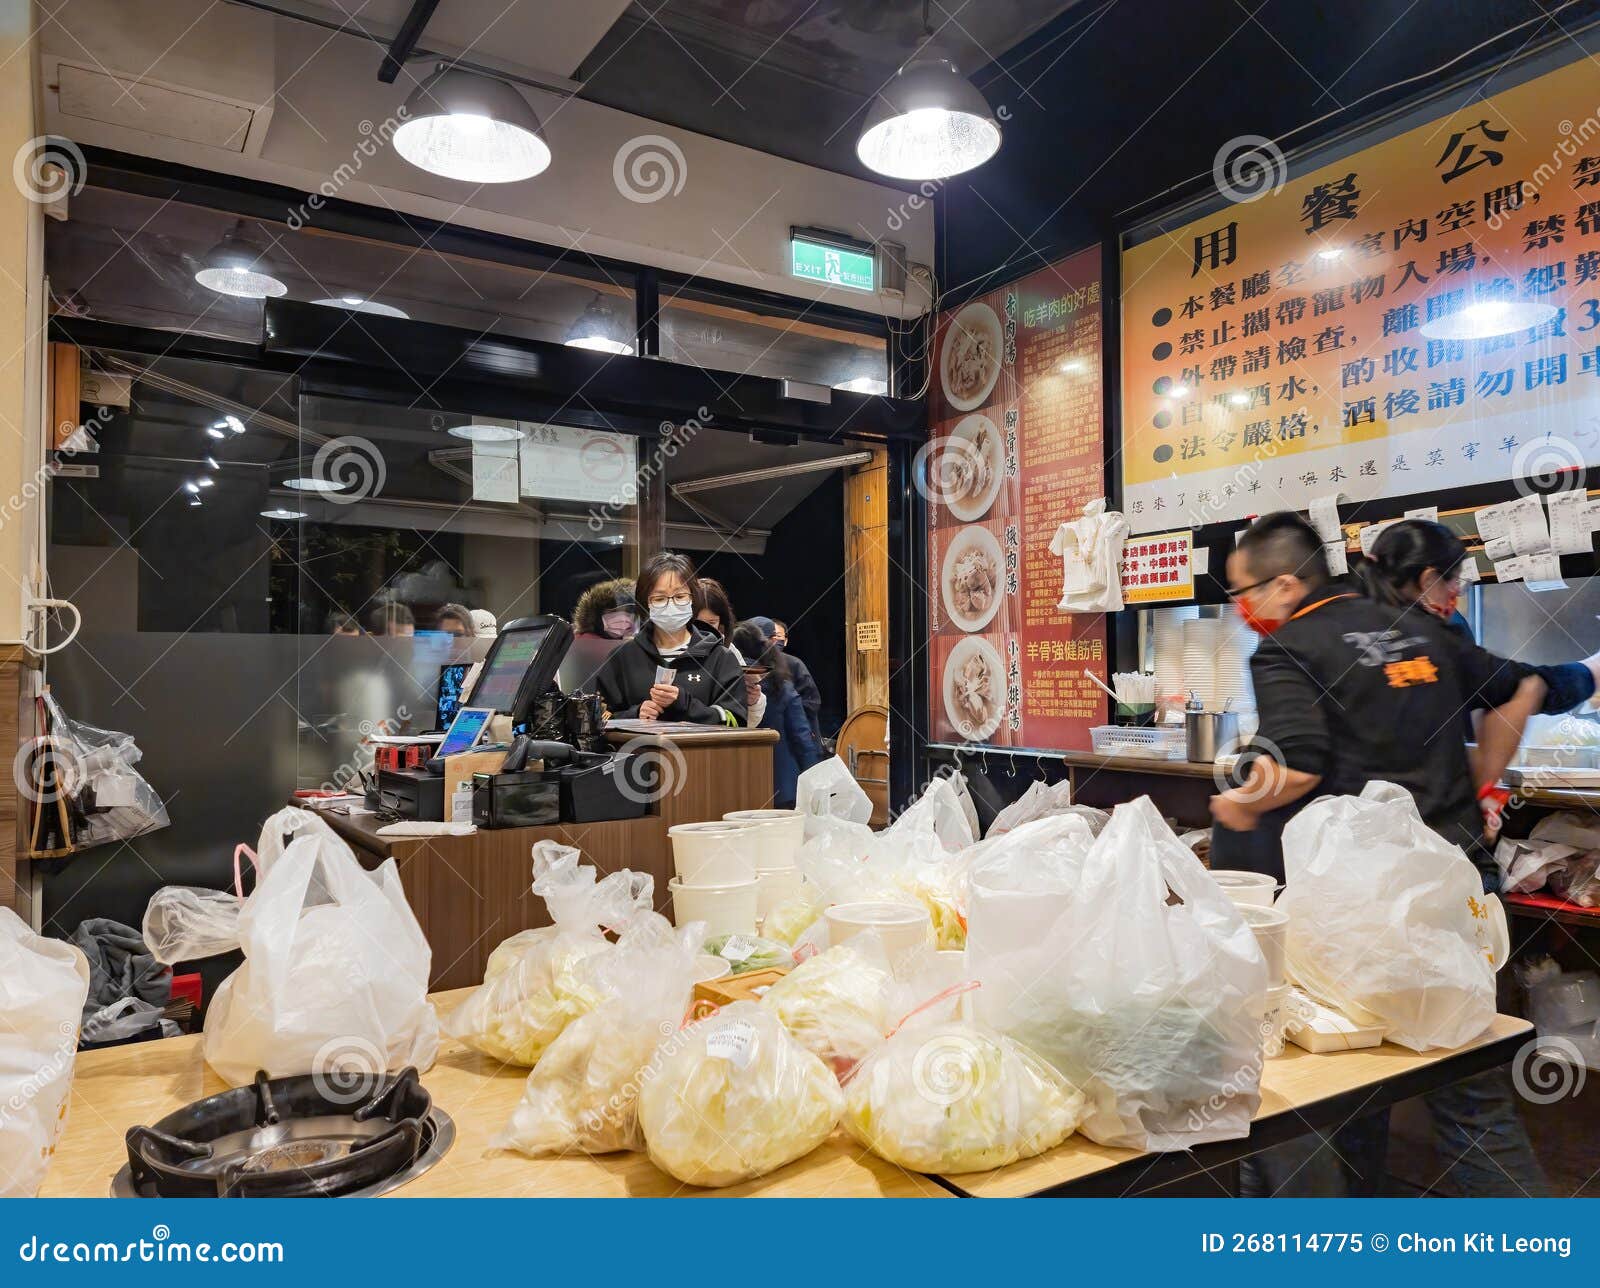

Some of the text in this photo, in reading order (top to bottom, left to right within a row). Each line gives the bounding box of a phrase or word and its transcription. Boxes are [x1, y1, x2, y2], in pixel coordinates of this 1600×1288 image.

[795, 263, 821, 275] EXIT
[1026, 639, 1104, 662] 羊骨強健筋骨
[1008, 641, 1020, 730] 小羊排湯
